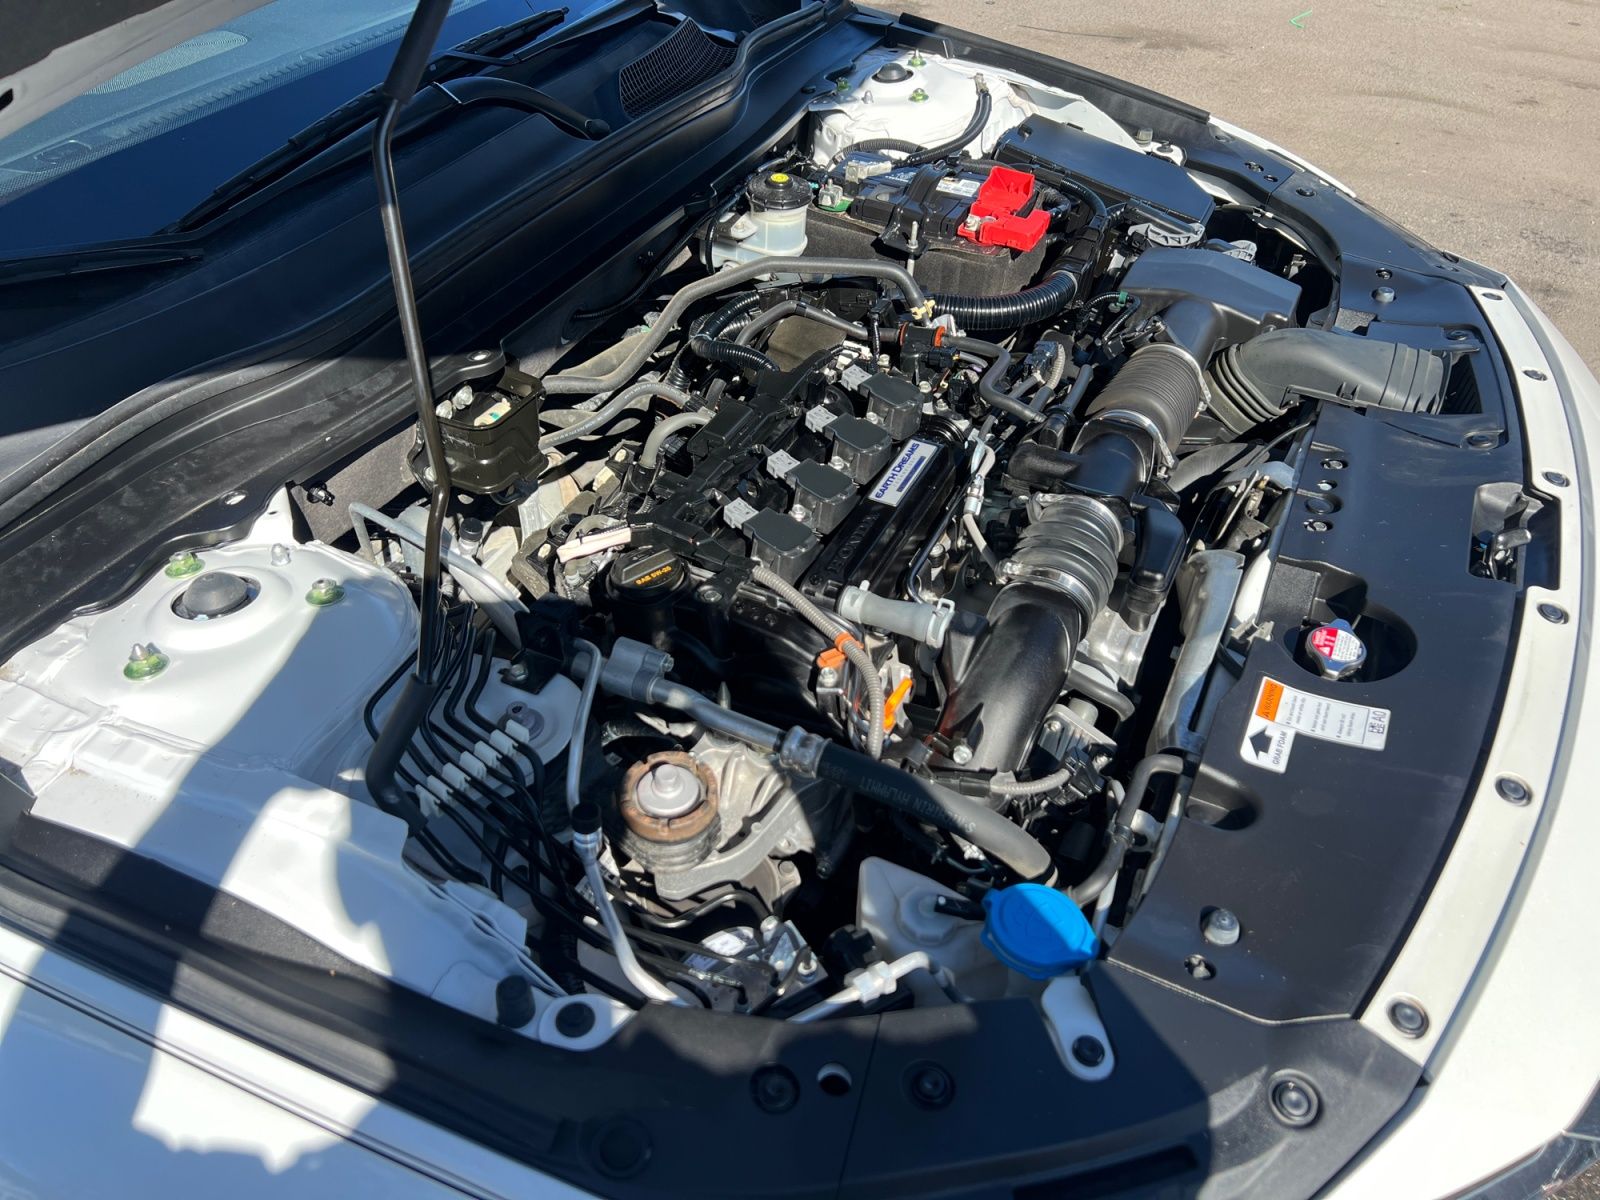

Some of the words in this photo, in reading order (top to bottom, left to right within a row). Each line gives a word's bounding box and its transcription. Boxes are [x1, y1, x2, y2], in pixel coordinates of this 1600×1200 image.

[875, 472, 899, 499] EARTH
[894, 442, 920, 474] DREAMS
[1265, 683, 1278, 711] WARNING
[1272, 747, 1282, 765] GRAB
[1278, 731, 1288, 748] FOAM
